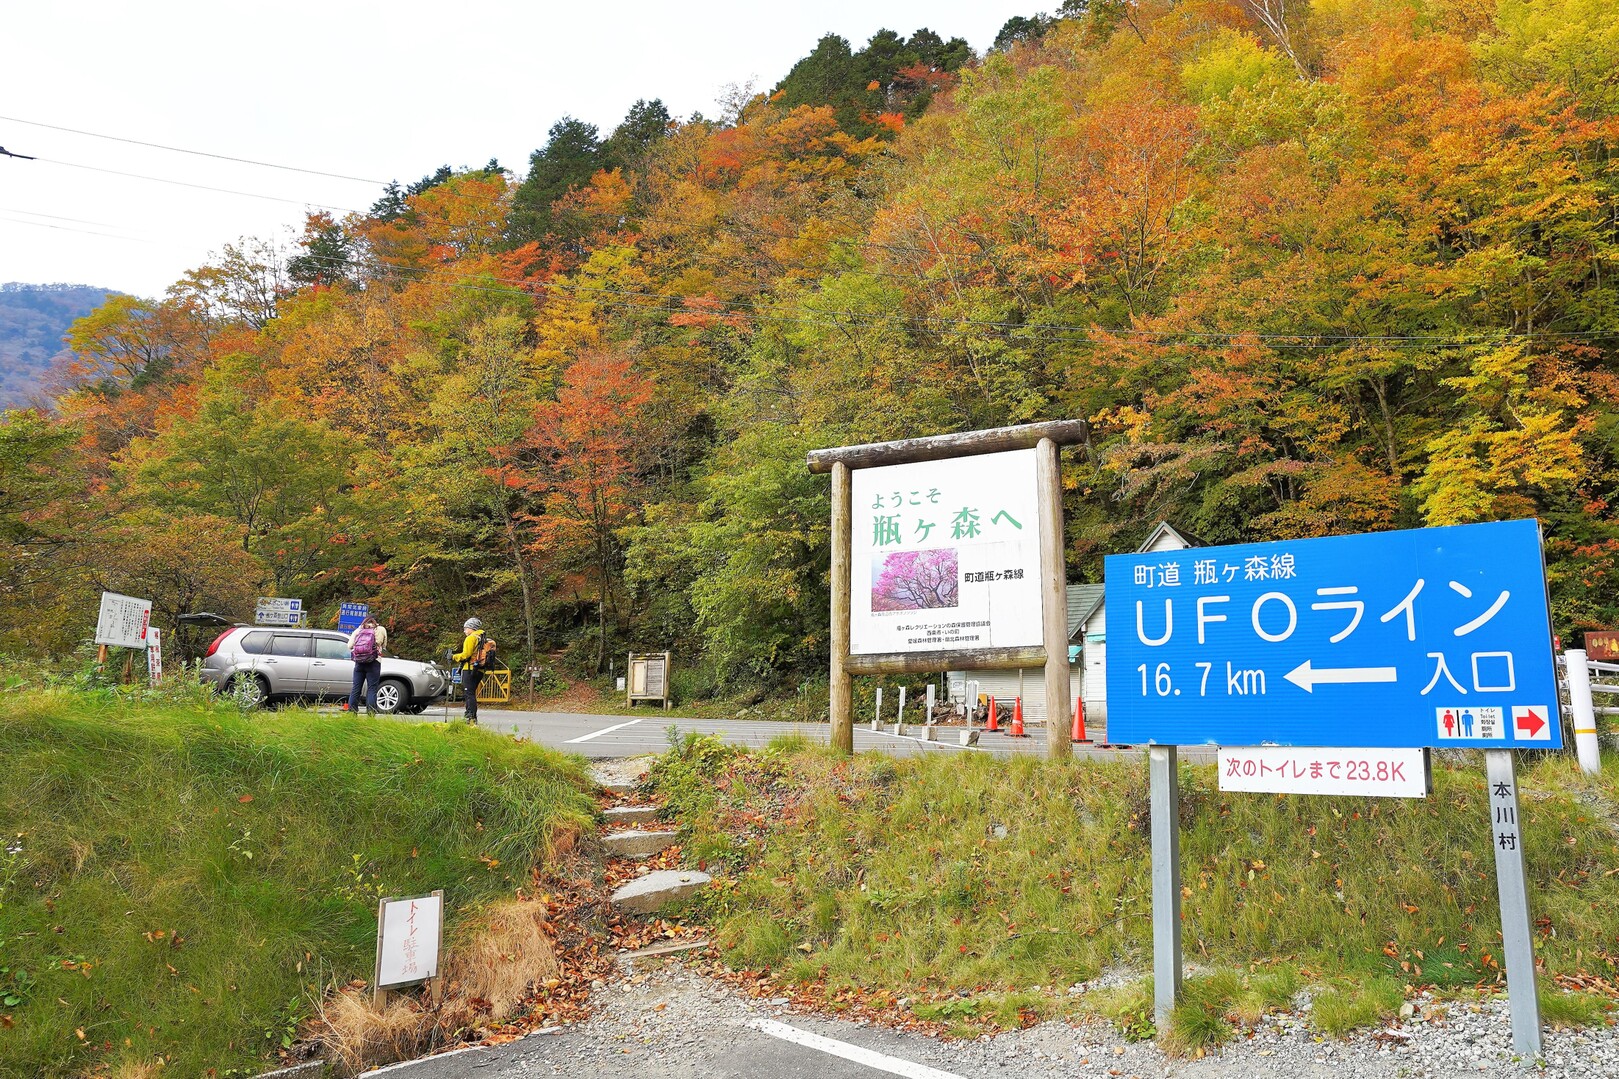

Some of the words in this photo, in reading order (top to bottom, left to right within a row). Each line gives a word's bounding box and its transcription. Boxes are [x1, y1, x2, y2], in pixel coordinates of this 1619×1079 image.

[872, 488, 941, 509] ようこそ
[872, 507, 1023, 546] 瓶ヶ森へ
[964, 568, 1024, 583] 町道瓶ヶ森線
[1134, 561, 1182, 588] 町道
[1193, 552, 1297, 585] 瓶ヶ森線
[1135, 578, 1511, 647] UFOライン
[1226, 661, 1266, 695] km
[1420, 651, 1516, 696] 入口
[1492, 781, 1517, 850] 本川村
